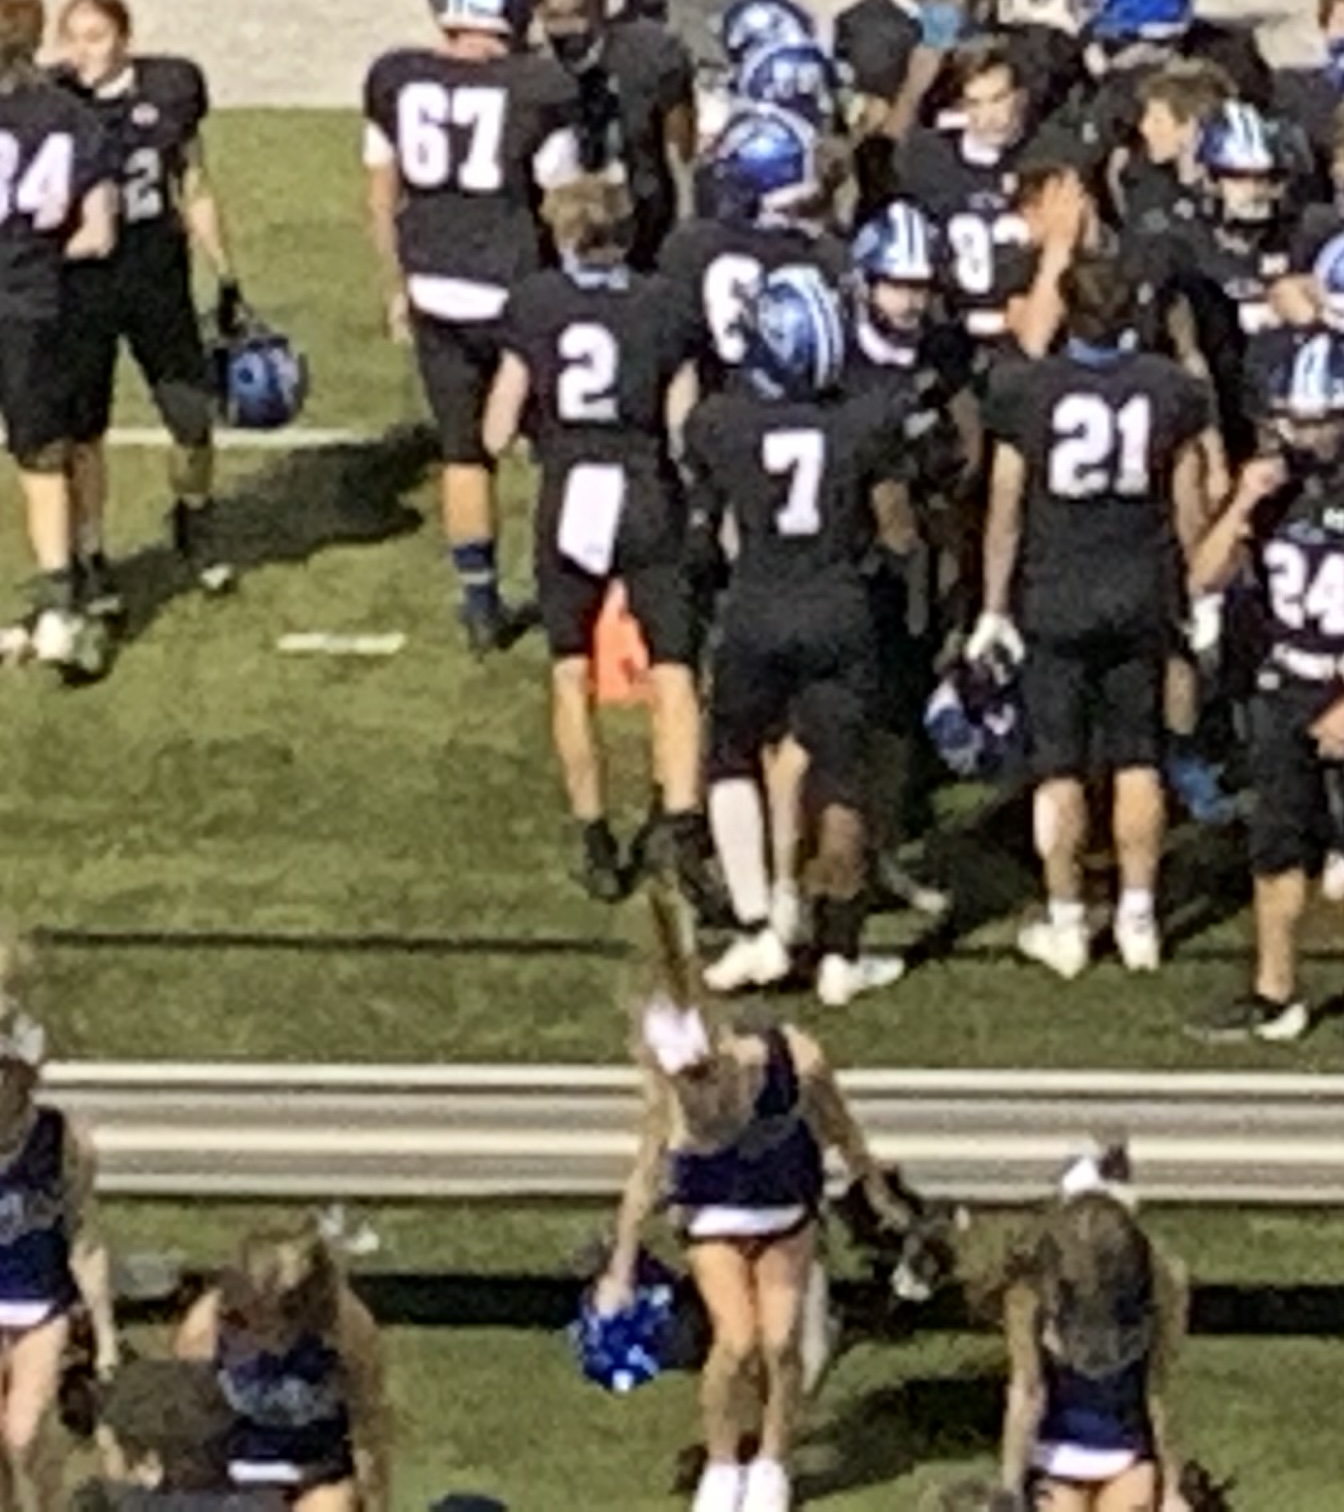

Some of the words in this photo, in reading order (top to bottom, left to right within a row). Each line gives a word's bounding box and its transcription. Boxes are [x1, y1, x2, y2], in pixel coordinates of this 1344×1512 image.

[397, 82, 505, 190] 67
[557, 320, 620, 422] 2
[762, 428, 825, 536] 7
[1048, 392, 1151, 499] 21
